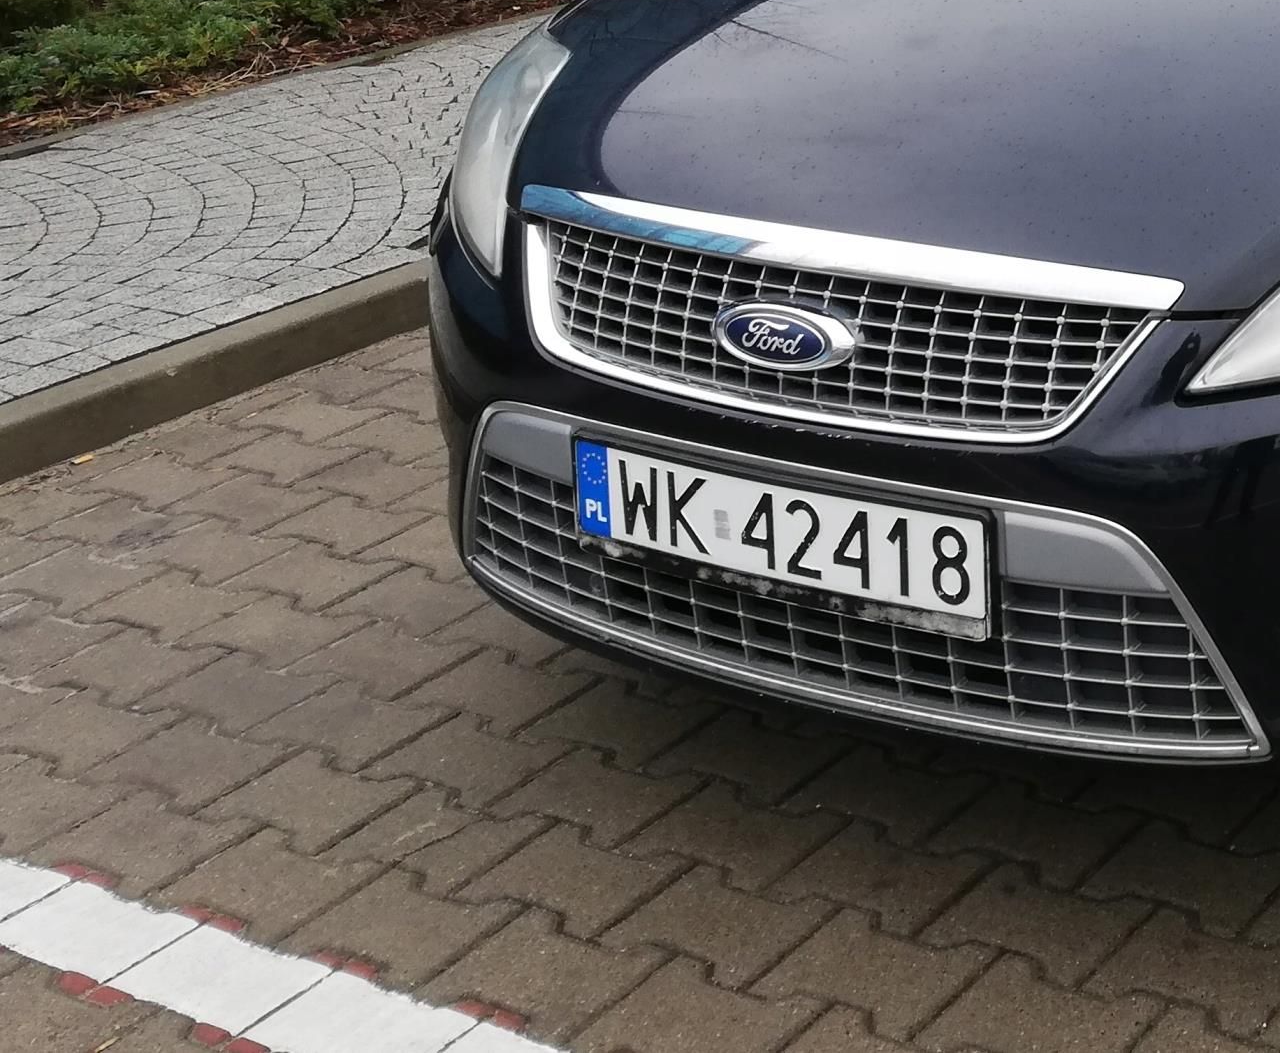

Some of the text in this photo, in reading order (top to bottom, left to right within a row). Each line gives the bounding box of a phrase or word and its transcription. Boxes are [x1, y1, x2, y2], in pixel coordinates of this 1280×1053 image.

[742, 319, 805, 355] Ford
[585, 498, 607, 523] PL
[618, 459, 970, 606] WK 42418
